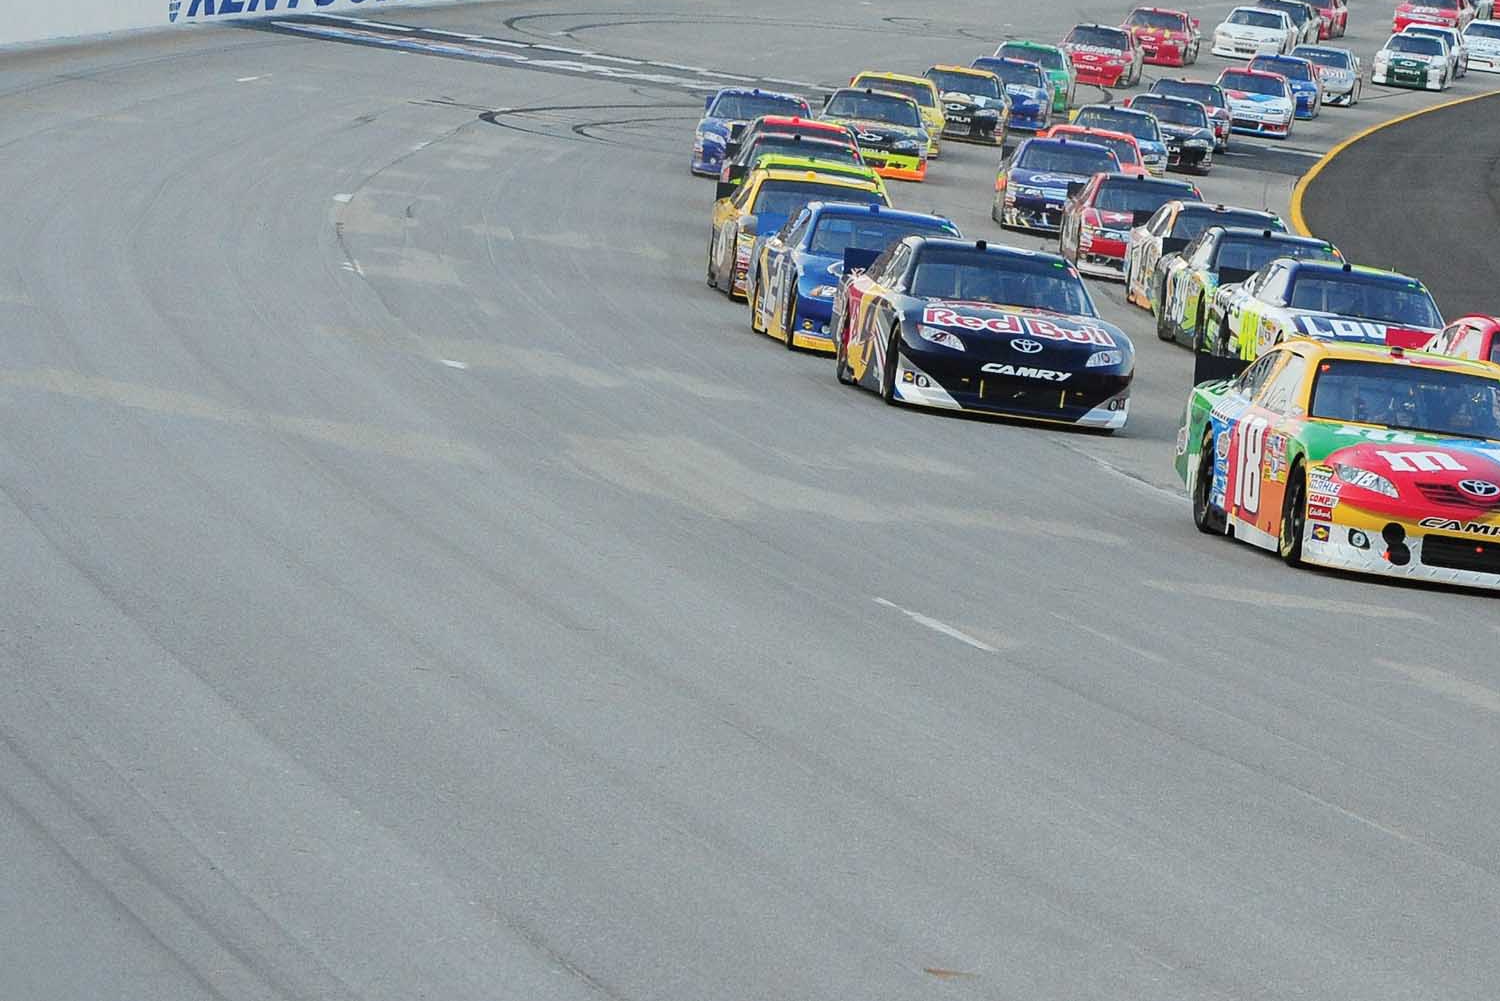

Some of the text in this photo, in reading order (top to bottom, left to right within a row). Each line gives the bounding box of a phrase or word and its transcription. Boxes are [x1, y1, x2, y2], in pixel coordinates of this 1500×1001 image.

[923, 307, 1117, 348] Red Bull
[980, 361, 1073, 382] CAMRY
[1233, 413, 1271, 515] 18
